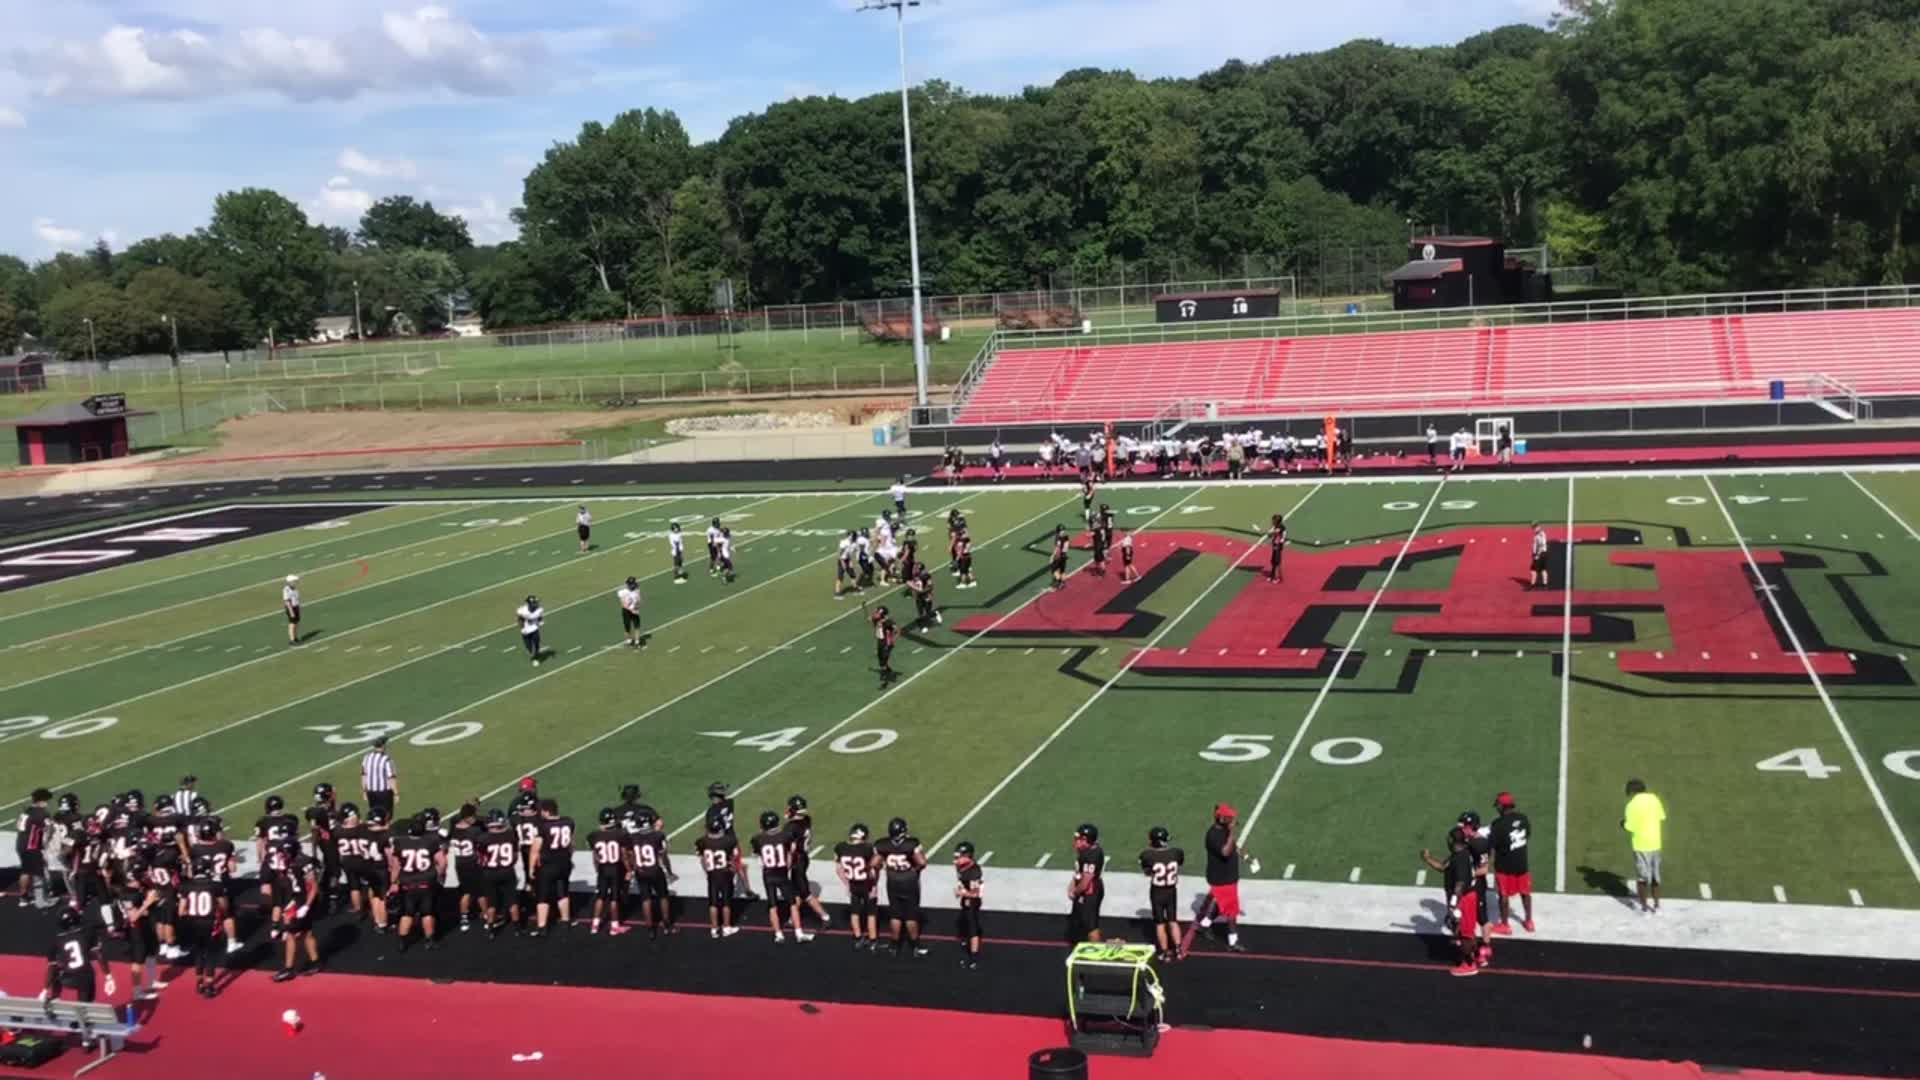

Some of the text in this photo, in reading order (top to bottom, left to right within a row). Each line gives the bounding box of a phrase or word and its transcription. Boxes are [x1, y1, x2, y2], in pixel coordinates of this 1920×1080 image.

[550, 826, 571, 849] 78
[402, 848, 430, 872] 76
[487, 843, 513, 867] 79
[595, 841, 619, 863] 30
[634, 845, 656, 867] 19
[761, 844, 786, 868] 81
[840, 856, 867, 880] 52
[1152, 861, 1178, 886] 22
[188, 891, 212, 917] 10
[63, 940, 84, 969] 3
